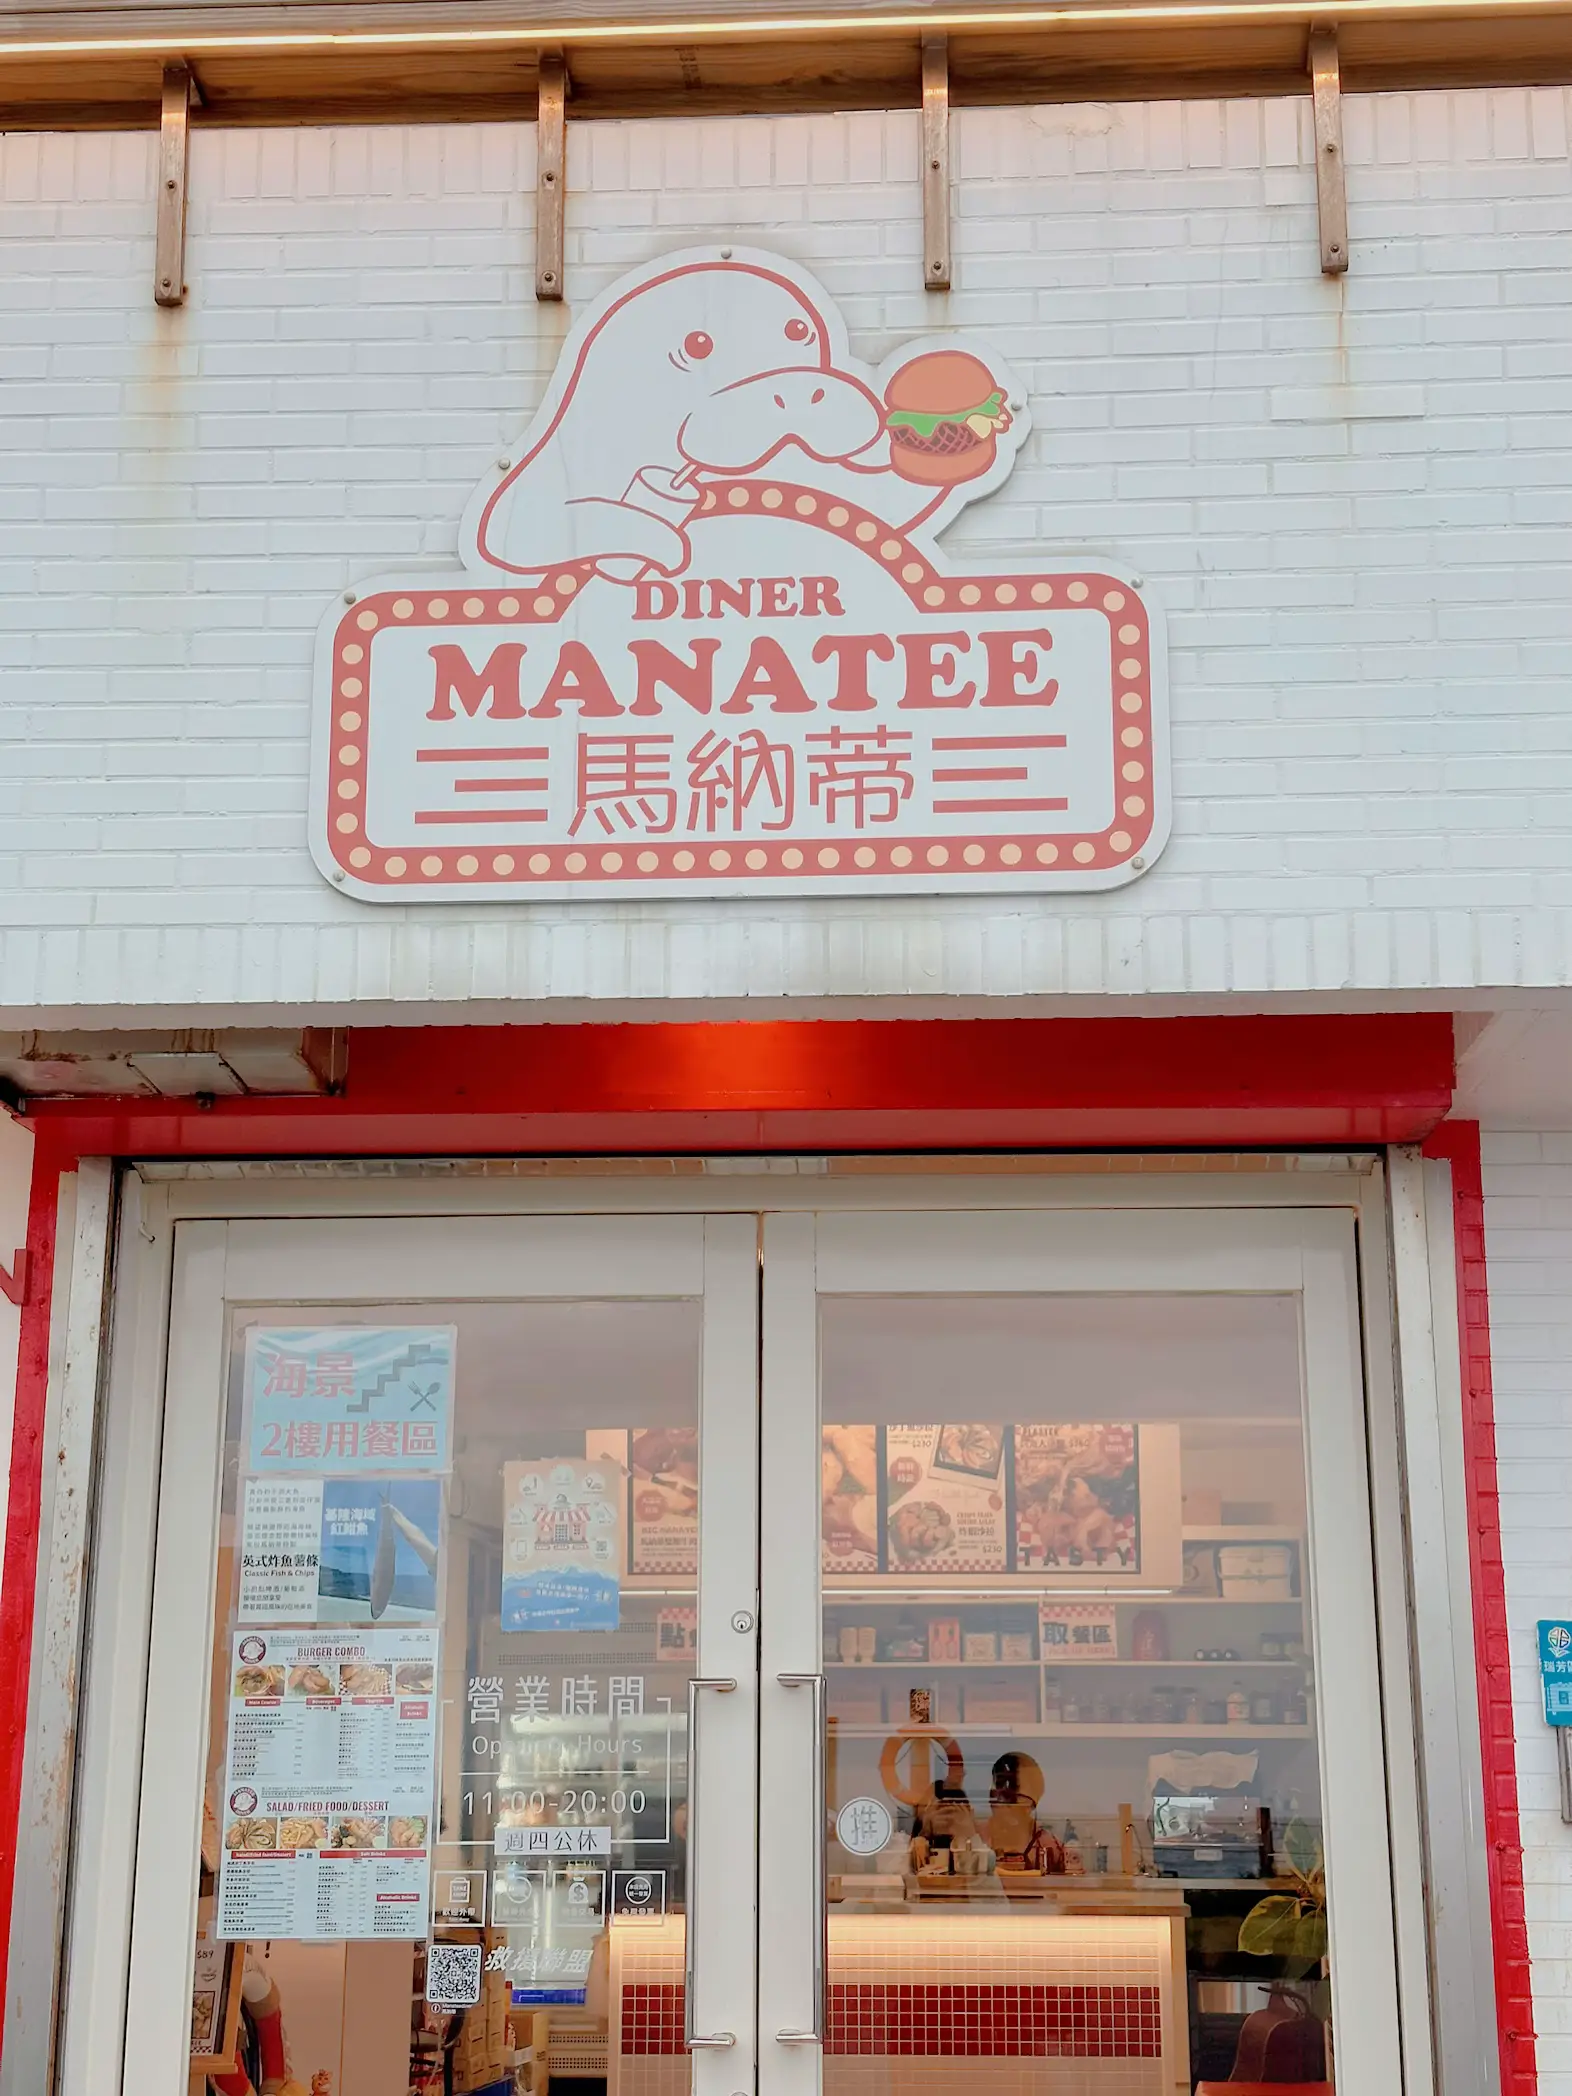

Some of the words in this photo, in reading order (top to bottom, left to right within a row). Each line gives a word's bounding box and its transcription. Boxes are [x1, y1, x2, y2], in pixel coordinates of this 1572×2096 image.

[631, 576, 845, 620] DINER
[426, 629, 1060, 721] MANATEE
[568, 725, 916, 838] 馬納蒂
[262, 1352, 358, 1398] 海景
[260, 1420, 439, 1459] 2樓用餐區
[242, 1554, 319, 1568] 英式炸魚薯條
[1018, 1545, 1131, 1567] TASTY
[244, 1569, 269, 1577] Classic
[270, 1569, 286, 1577] Fish
[294, 1569, 315, 1578] Chips
[1042, 1622, 1112, 1646] 取餐區
[297, 1647, 332, 1657] BURGER
[334, 1646, 366, 1656] COMBO
[467, 1675, 644, 1725] 營業時間
[578, 1735, 643, 1753] Hours
[266, 1801, 323, 1812] SALAD/FRIED
[325, 1800, 389, 1811] FOOD/DESSERT
[463, 1790, 647, 1815] 11:00-20:00
[504, 1829, 598, 1851] 週四公休
[442, 1907, 476, 1917] 歡迎外帶
